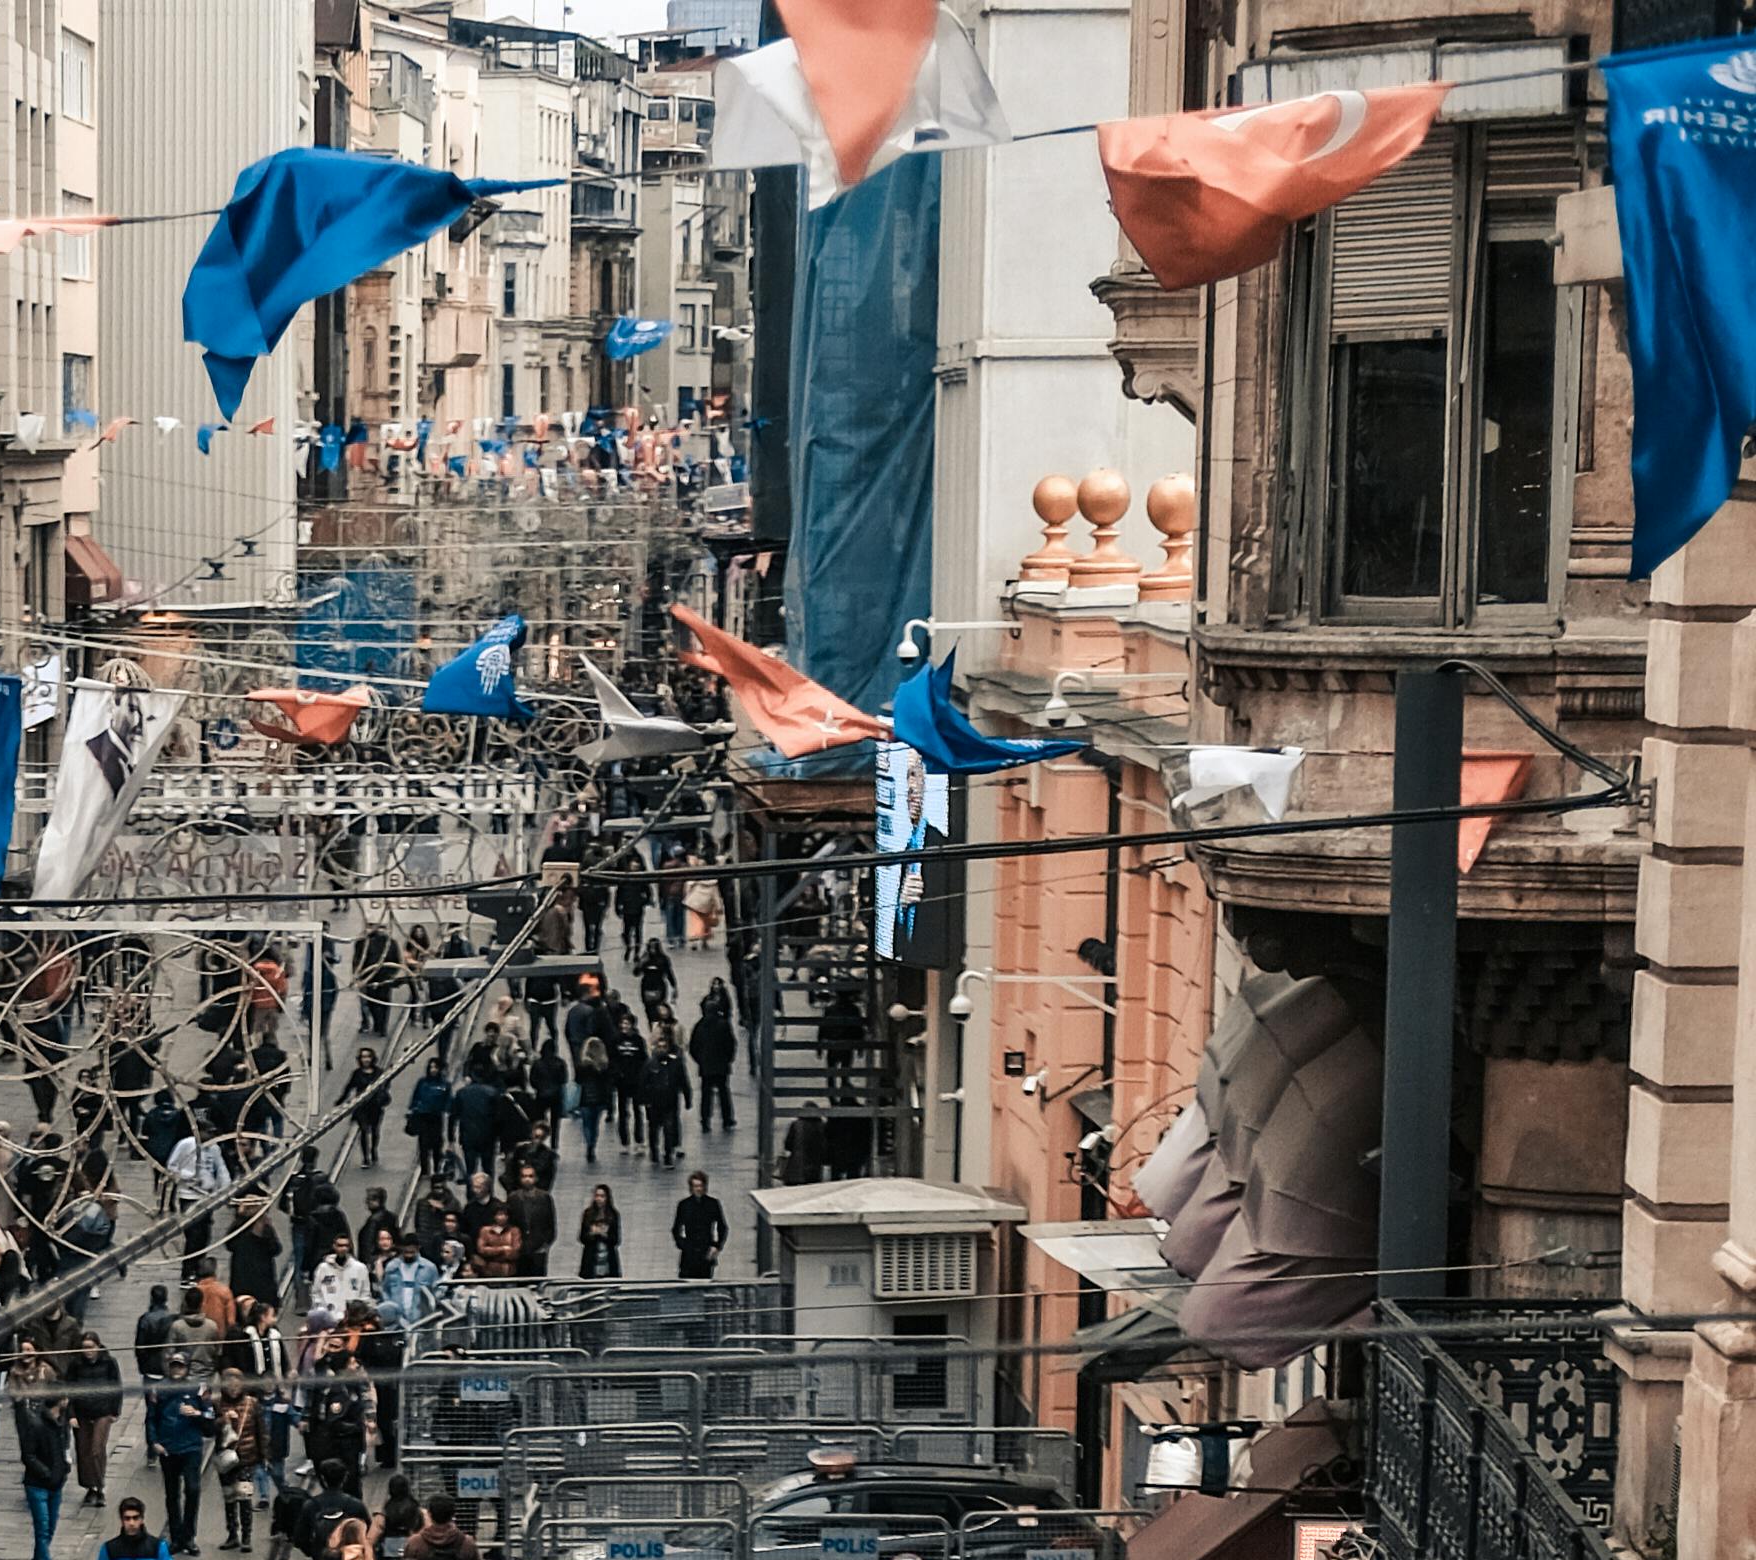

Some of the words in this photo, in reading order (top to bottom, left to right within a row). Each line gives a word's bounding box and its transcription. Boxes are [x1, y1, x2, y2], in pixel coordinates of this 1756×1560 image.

[462, 1375, 509, 1392] POLİS
[460, 1477, 501, 1491] POLİ
[610, 1541, 665, 1559] POLİS
[821, 1535, 878, 1556] POLİS
